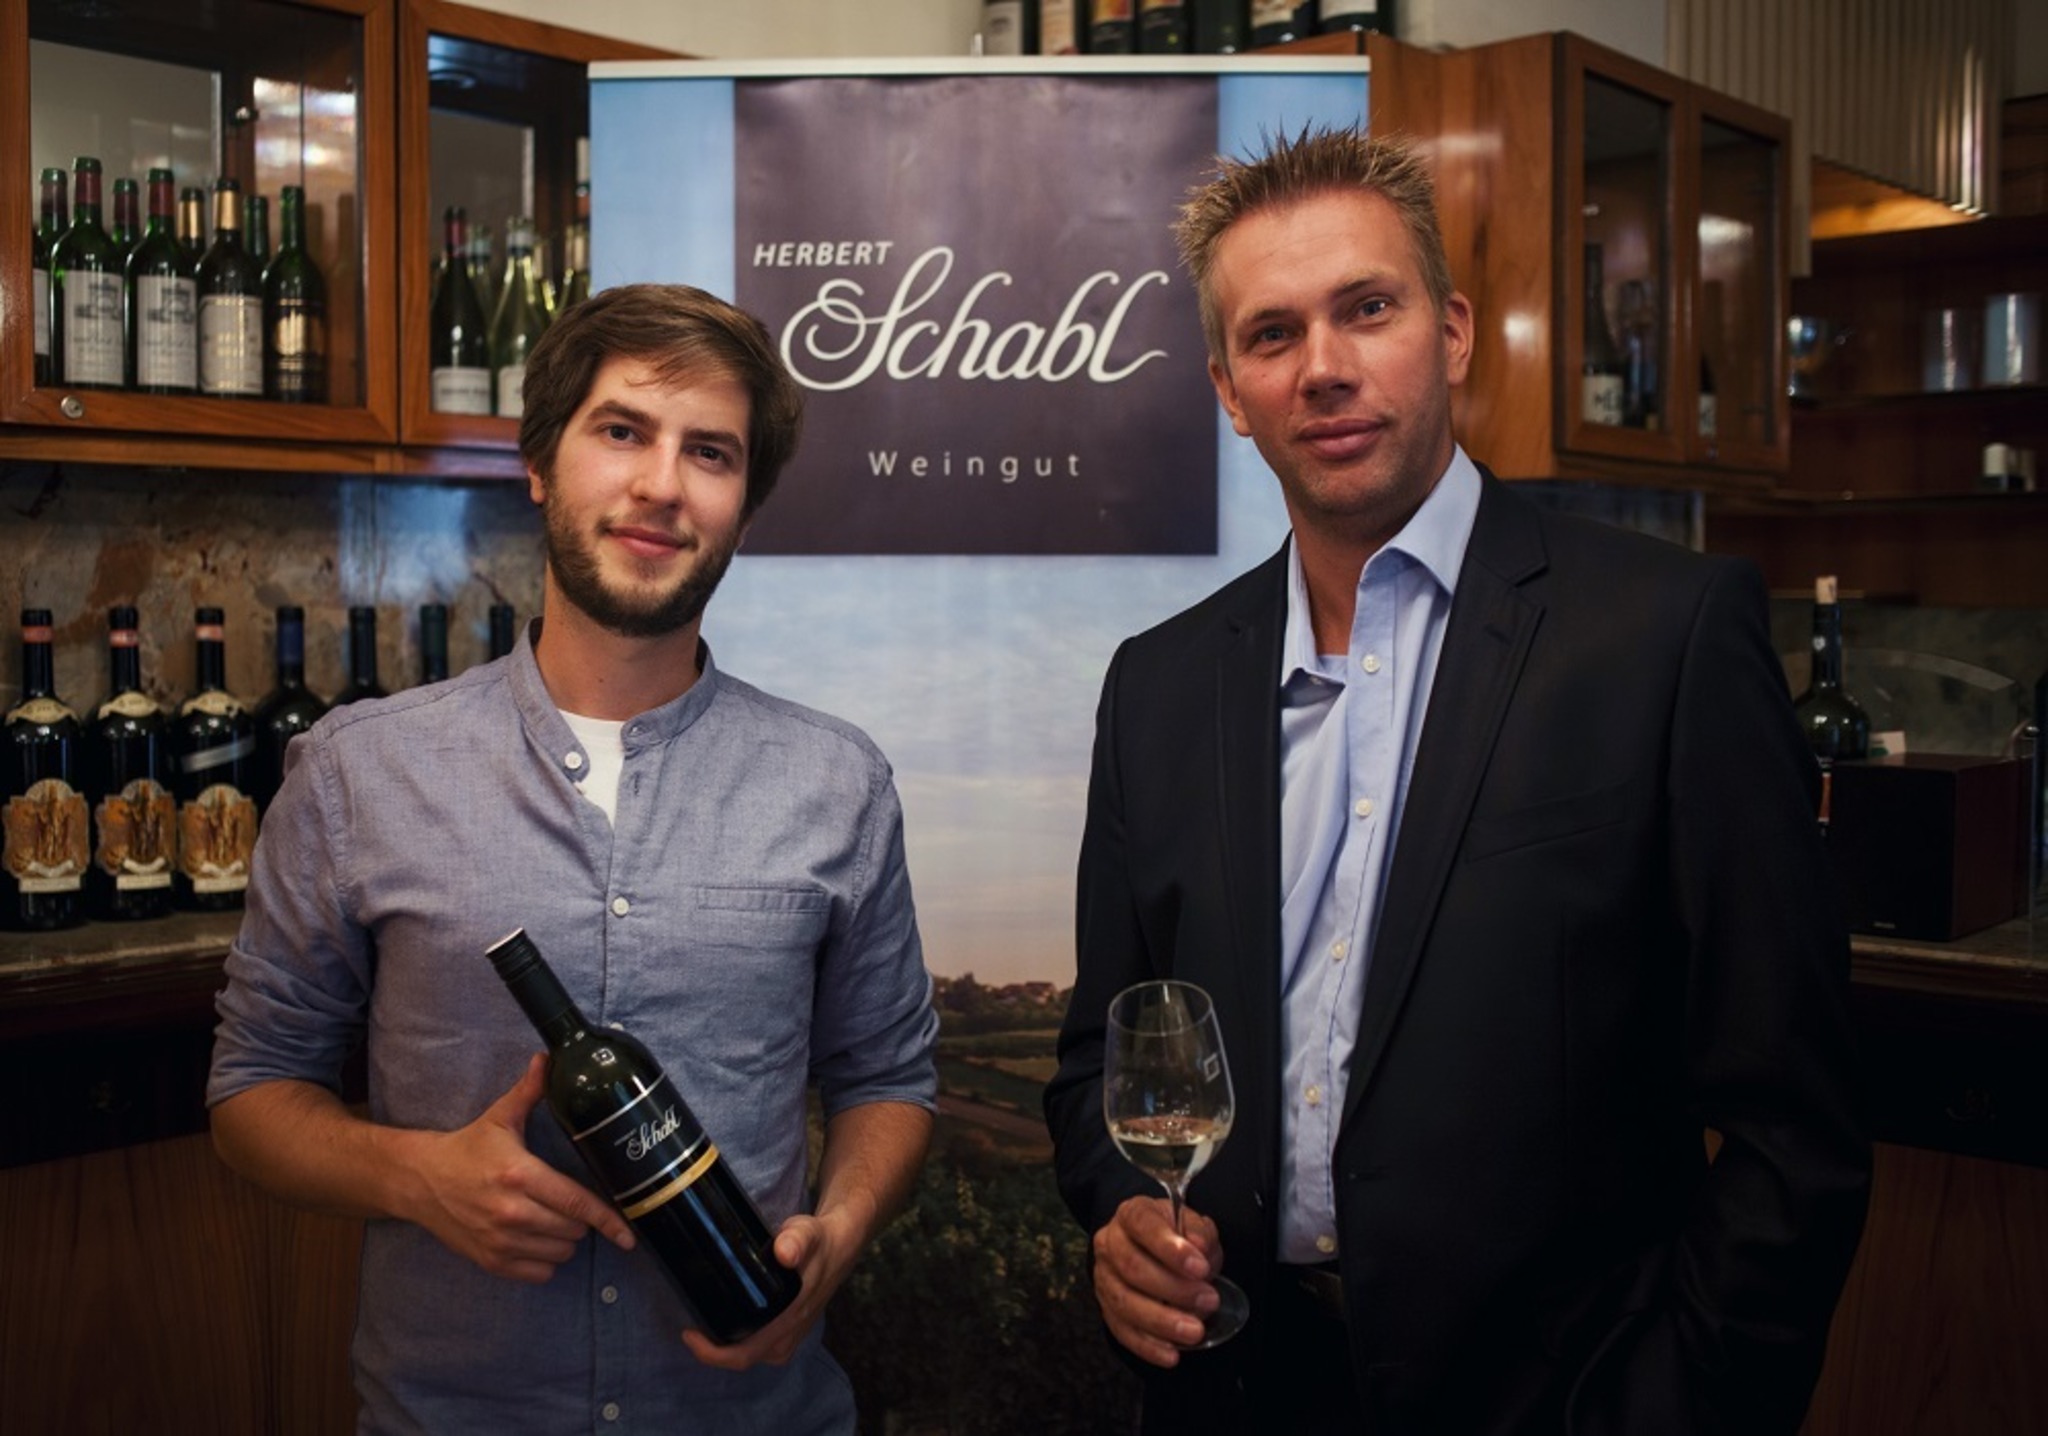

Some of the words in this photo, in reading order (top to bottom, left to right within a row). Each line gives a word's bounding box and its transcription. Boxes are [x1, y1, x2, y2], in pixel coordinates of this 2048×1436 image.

[752, 240, 895, 267] HERBERT
[779, 245, 1169, 391] Schabl
[867, 450, 1081, 483] Weingut
[625, 1104, 682, 1161] Schabl
